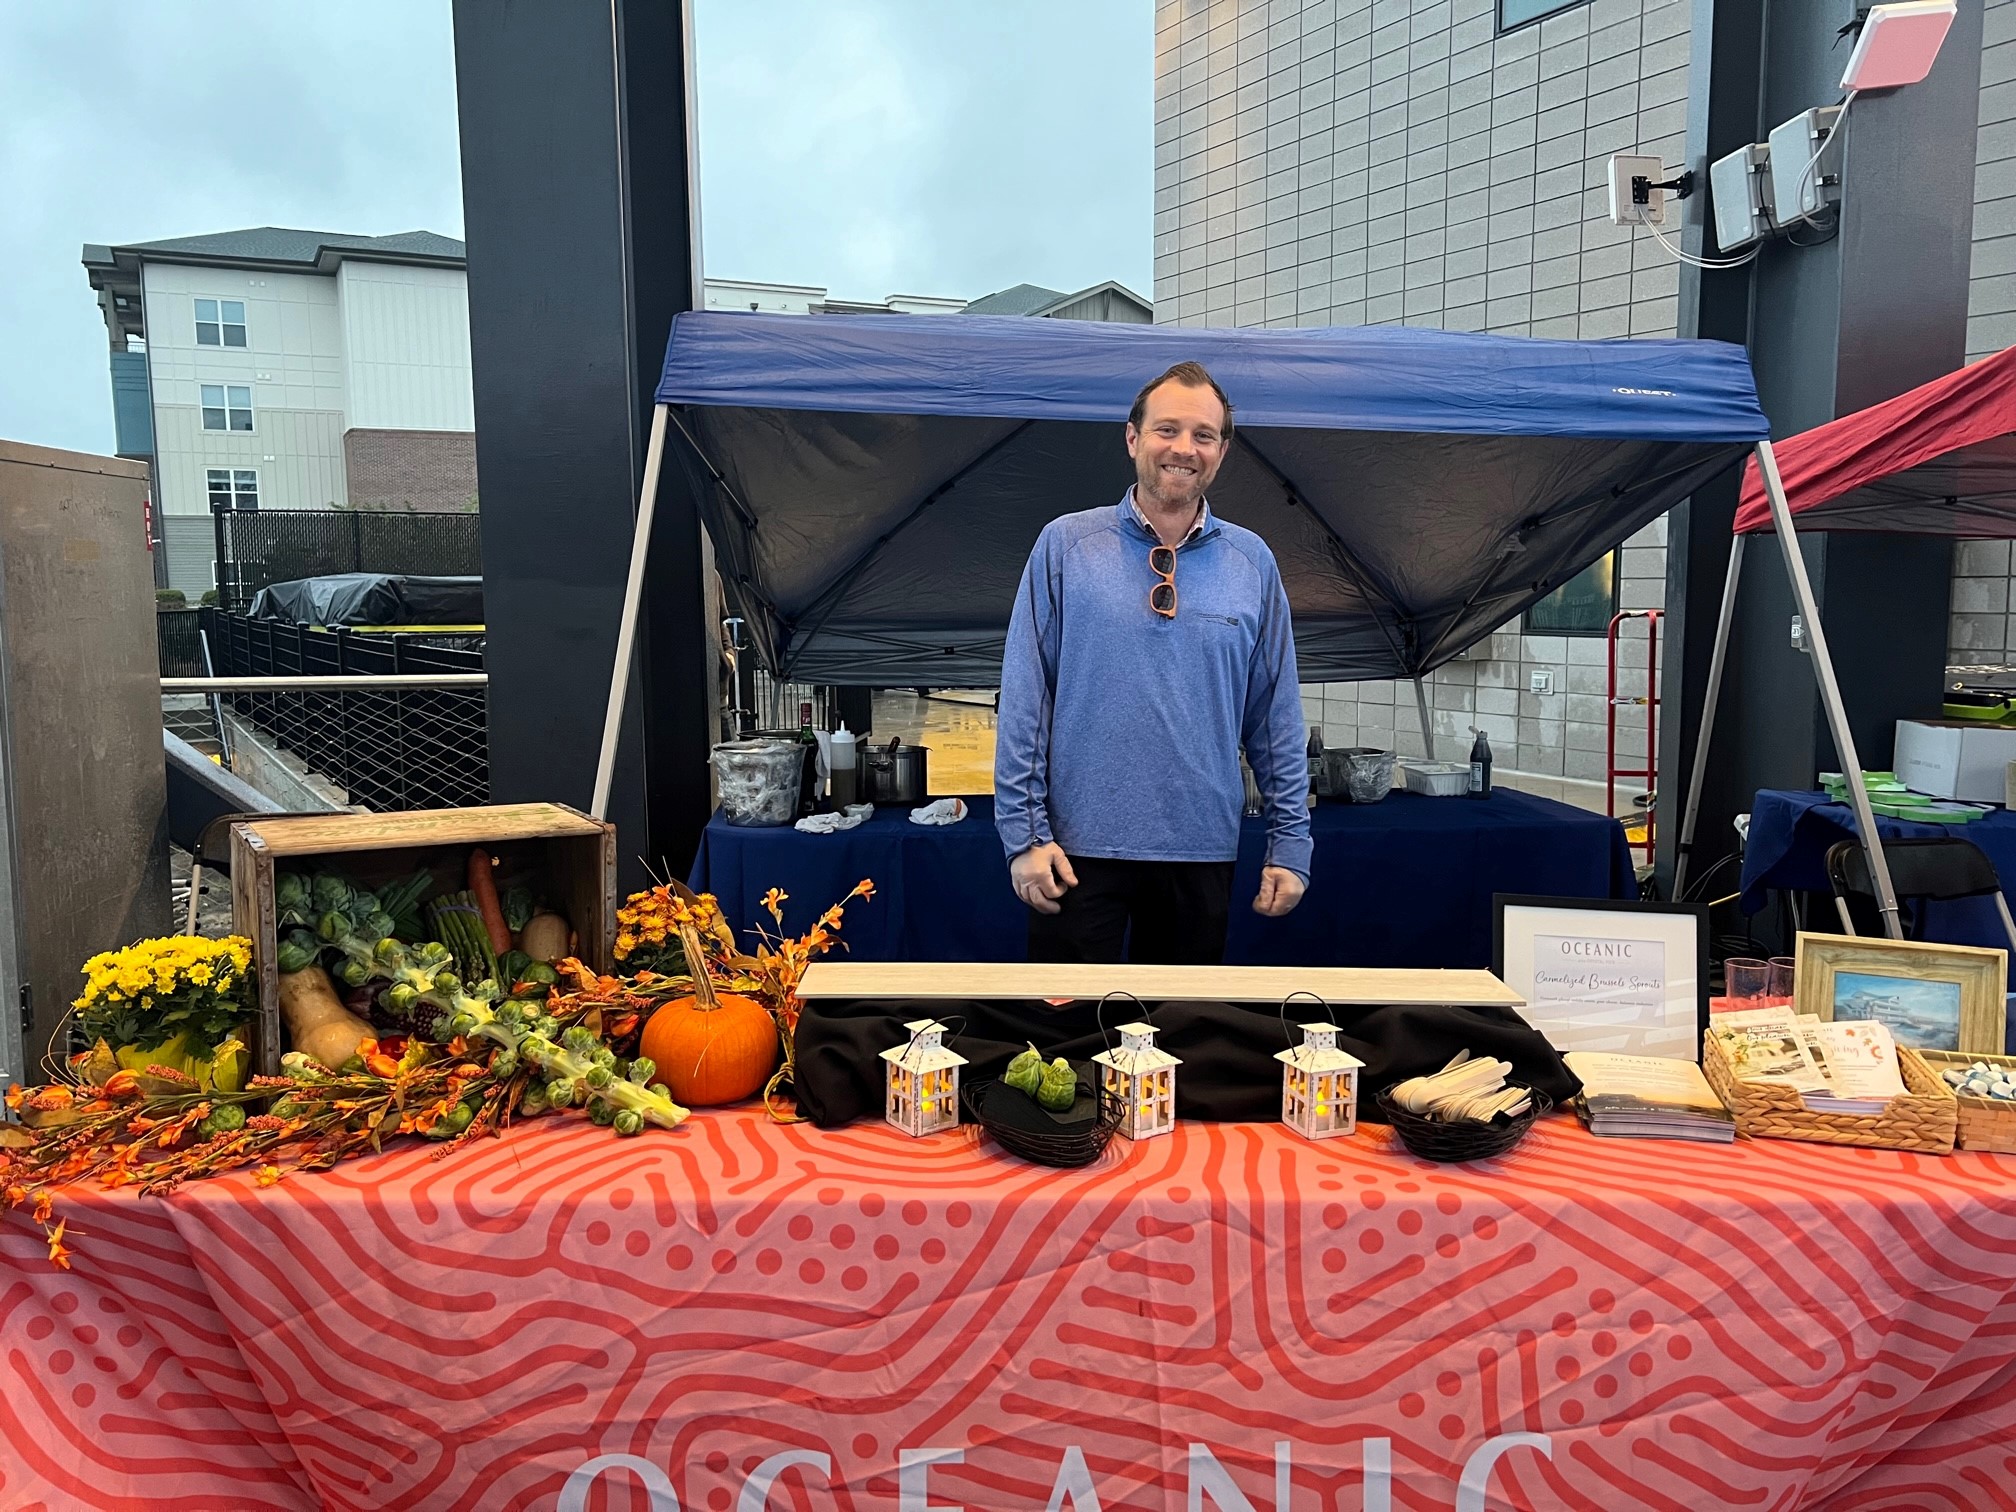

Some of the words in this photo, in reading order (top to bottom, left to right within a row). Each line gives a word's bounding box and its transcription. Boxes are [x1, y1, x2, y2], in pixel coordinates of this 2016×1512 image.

[1561, 941, 1632, 958] OCEANIC
[1535, 970, 1586, 988] Carmelized
[1588, 973, 1625, 990] Brussels
[1628, 975, 1661, 992] Sprouts
